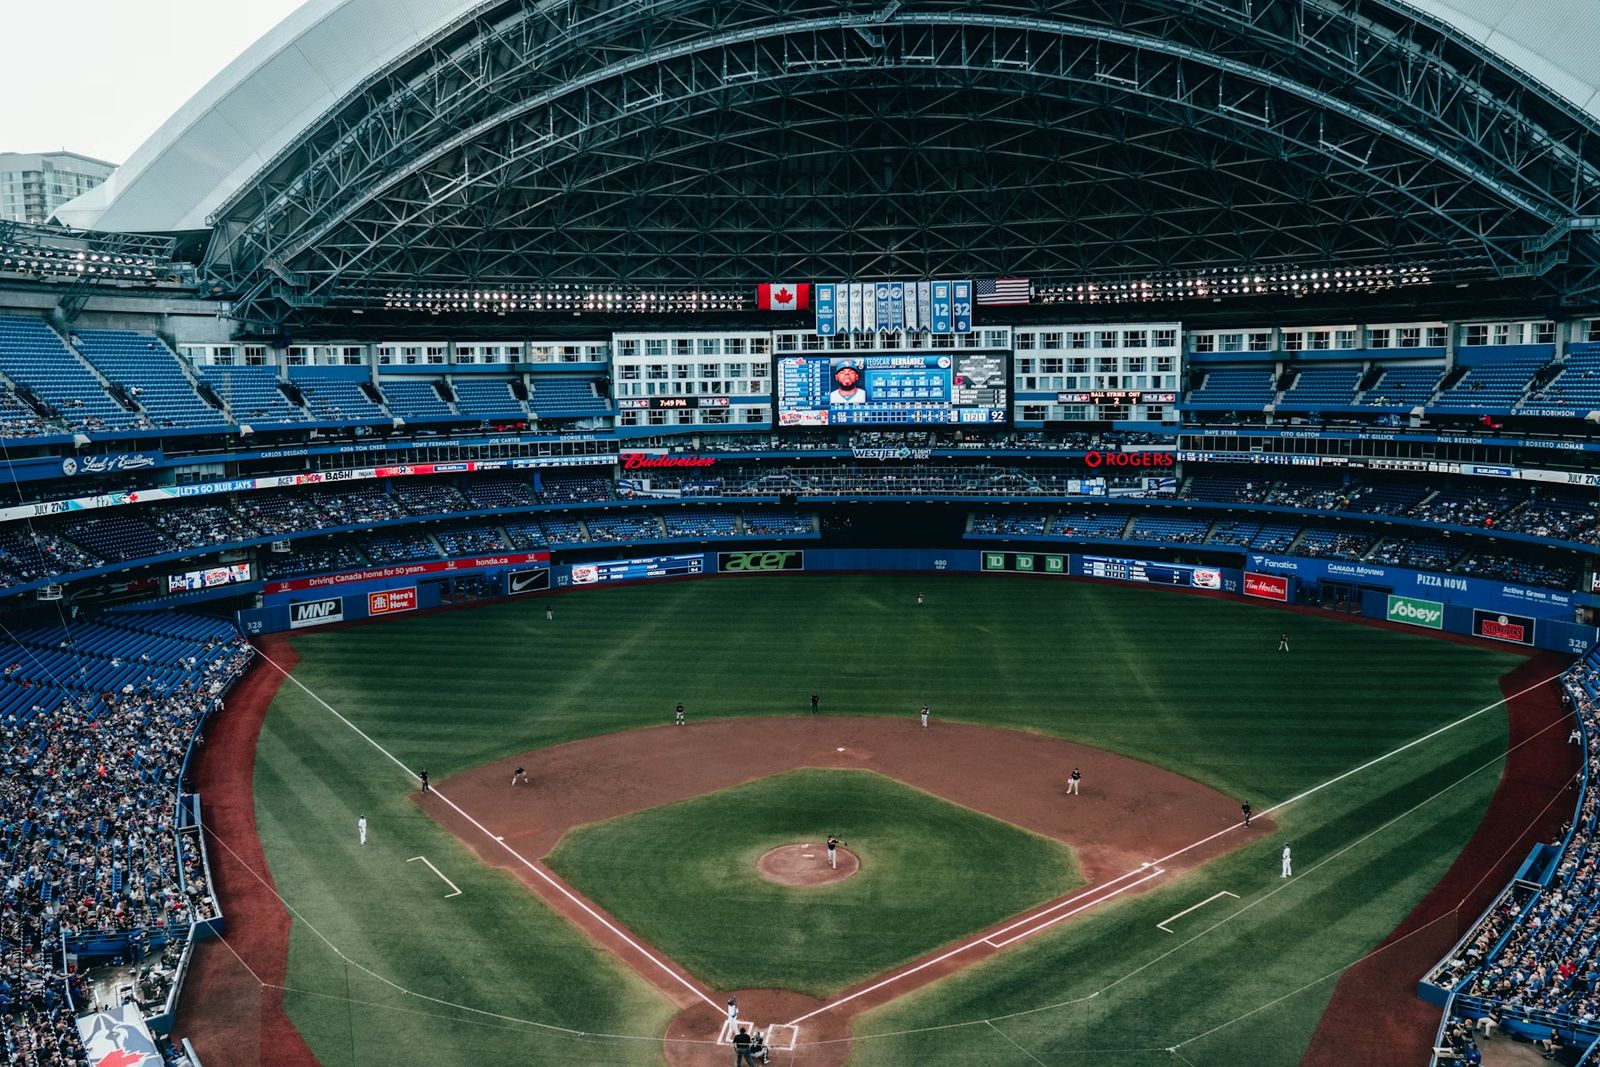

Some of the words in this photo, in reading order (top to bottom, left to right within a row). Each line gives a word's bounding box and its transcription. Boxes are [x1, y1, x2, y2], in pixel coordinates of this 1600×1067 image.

[934, 304, 948, 316] 12
[954, 303, 970, 316] 32
[991, 411, 1004, 420] 92
[853, 449, 896, 460] WESTJET
[1106, 452, 1174, 467] ROGERS
[80, 456, 108, 472] Level
[107, 458, 118, 471] of
[620, 453, 716, 470] Budweiser
[325, 470, 353, 481] BASH!
[1568, 473, 1582, 483] JULY
[180, 486, 200, 495] LET'S
[201, 485, 213, 494] GO
[214, 482, 232, 492] BLUE
[233, 480, 252, 490] JAYS
[34, 504, 48, 515] JULY
[476, 557, 508, 566] honda.ca
[724, 551, 796, 570] acer
[1264, 558, 1298, 570] Fanatics
[1327, 563, 1355, 573] CANADA
[1356, 566, 1384, 576] MOVING
[310, 576, 334, 587] Driving
[335, 572, 362, 582] Canada
[363, 571, 382, 579] home
[405, 566, 426, 575] years.
[1417, 573, 1442, 587] PIZZA
[1443, 578, 1468, 592] NOVA
[1225, 579, 1237, 587] 375
[1246, 579, 1258, 590] Tim
[1259, 581, 1284, 595] Hortons
[390, 591, 414, 601] Here's
[1503, 586, 1524, 596] Active
[1526, 590, 1546, 599] Green
[1551, 594, 1569, 603] Ross
[297, 601, 336, 620] MNP
[390, 601, 409, 609] How.
[1390, 600, 1440, 622] Sobeys
[247, 621, 263, 630] 328
[1568, 639, 1588, 649] 328
